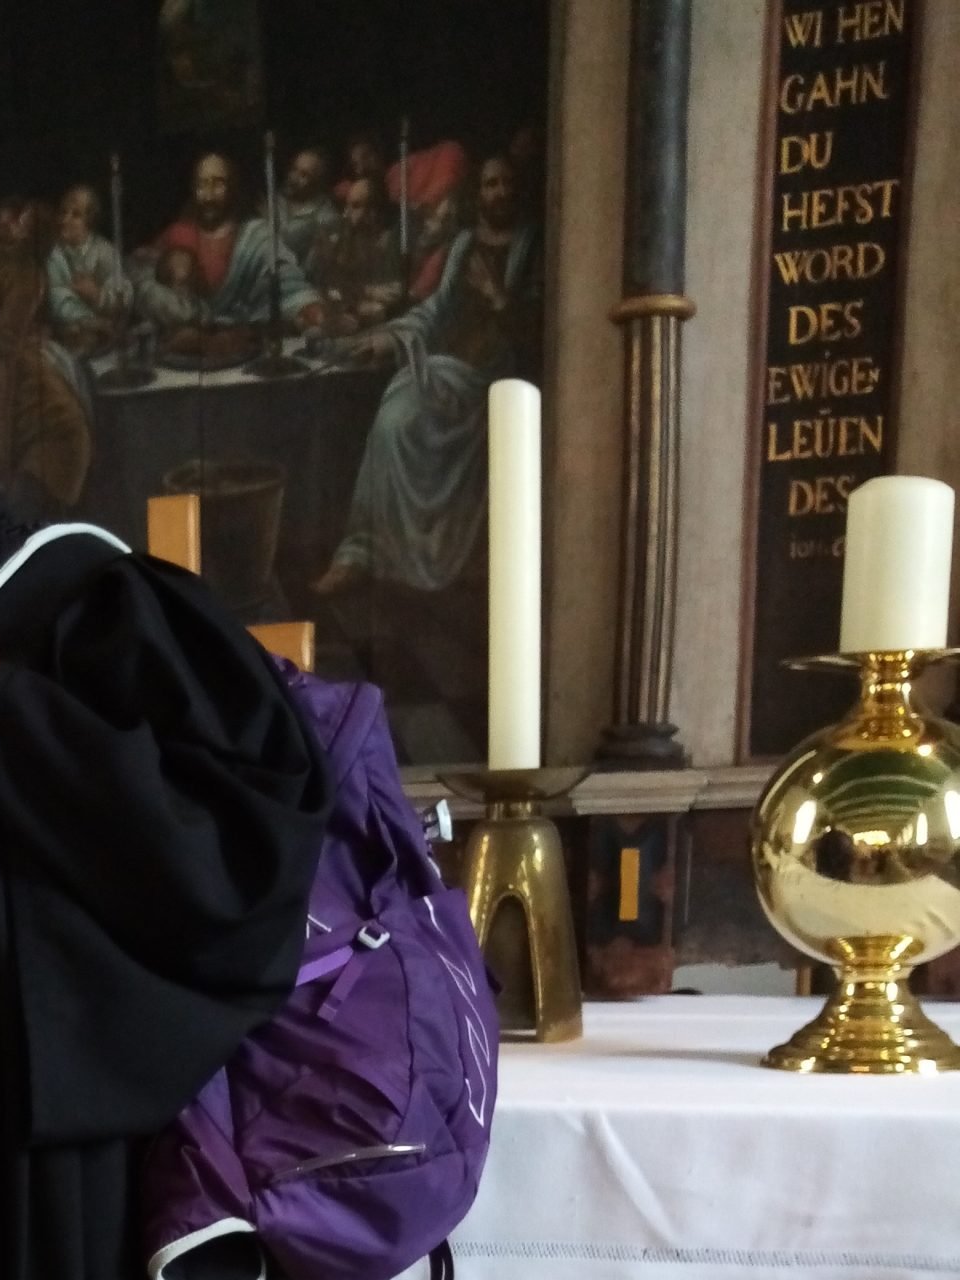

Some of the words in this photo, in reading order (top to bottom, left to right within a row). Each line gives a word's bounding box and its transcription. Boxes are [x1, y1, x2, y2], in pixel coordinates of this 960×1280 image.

[785, 10, 824, 48] WI
[835, 0, 905, 43] HEN
[780, 60, 890, 114] GAHN
[779, 131, 834, 175] DU
[781, 179, 900, 233] HEFST
[774, 241, 886, 286] WORD
[787, 298, 864, 346] DES
